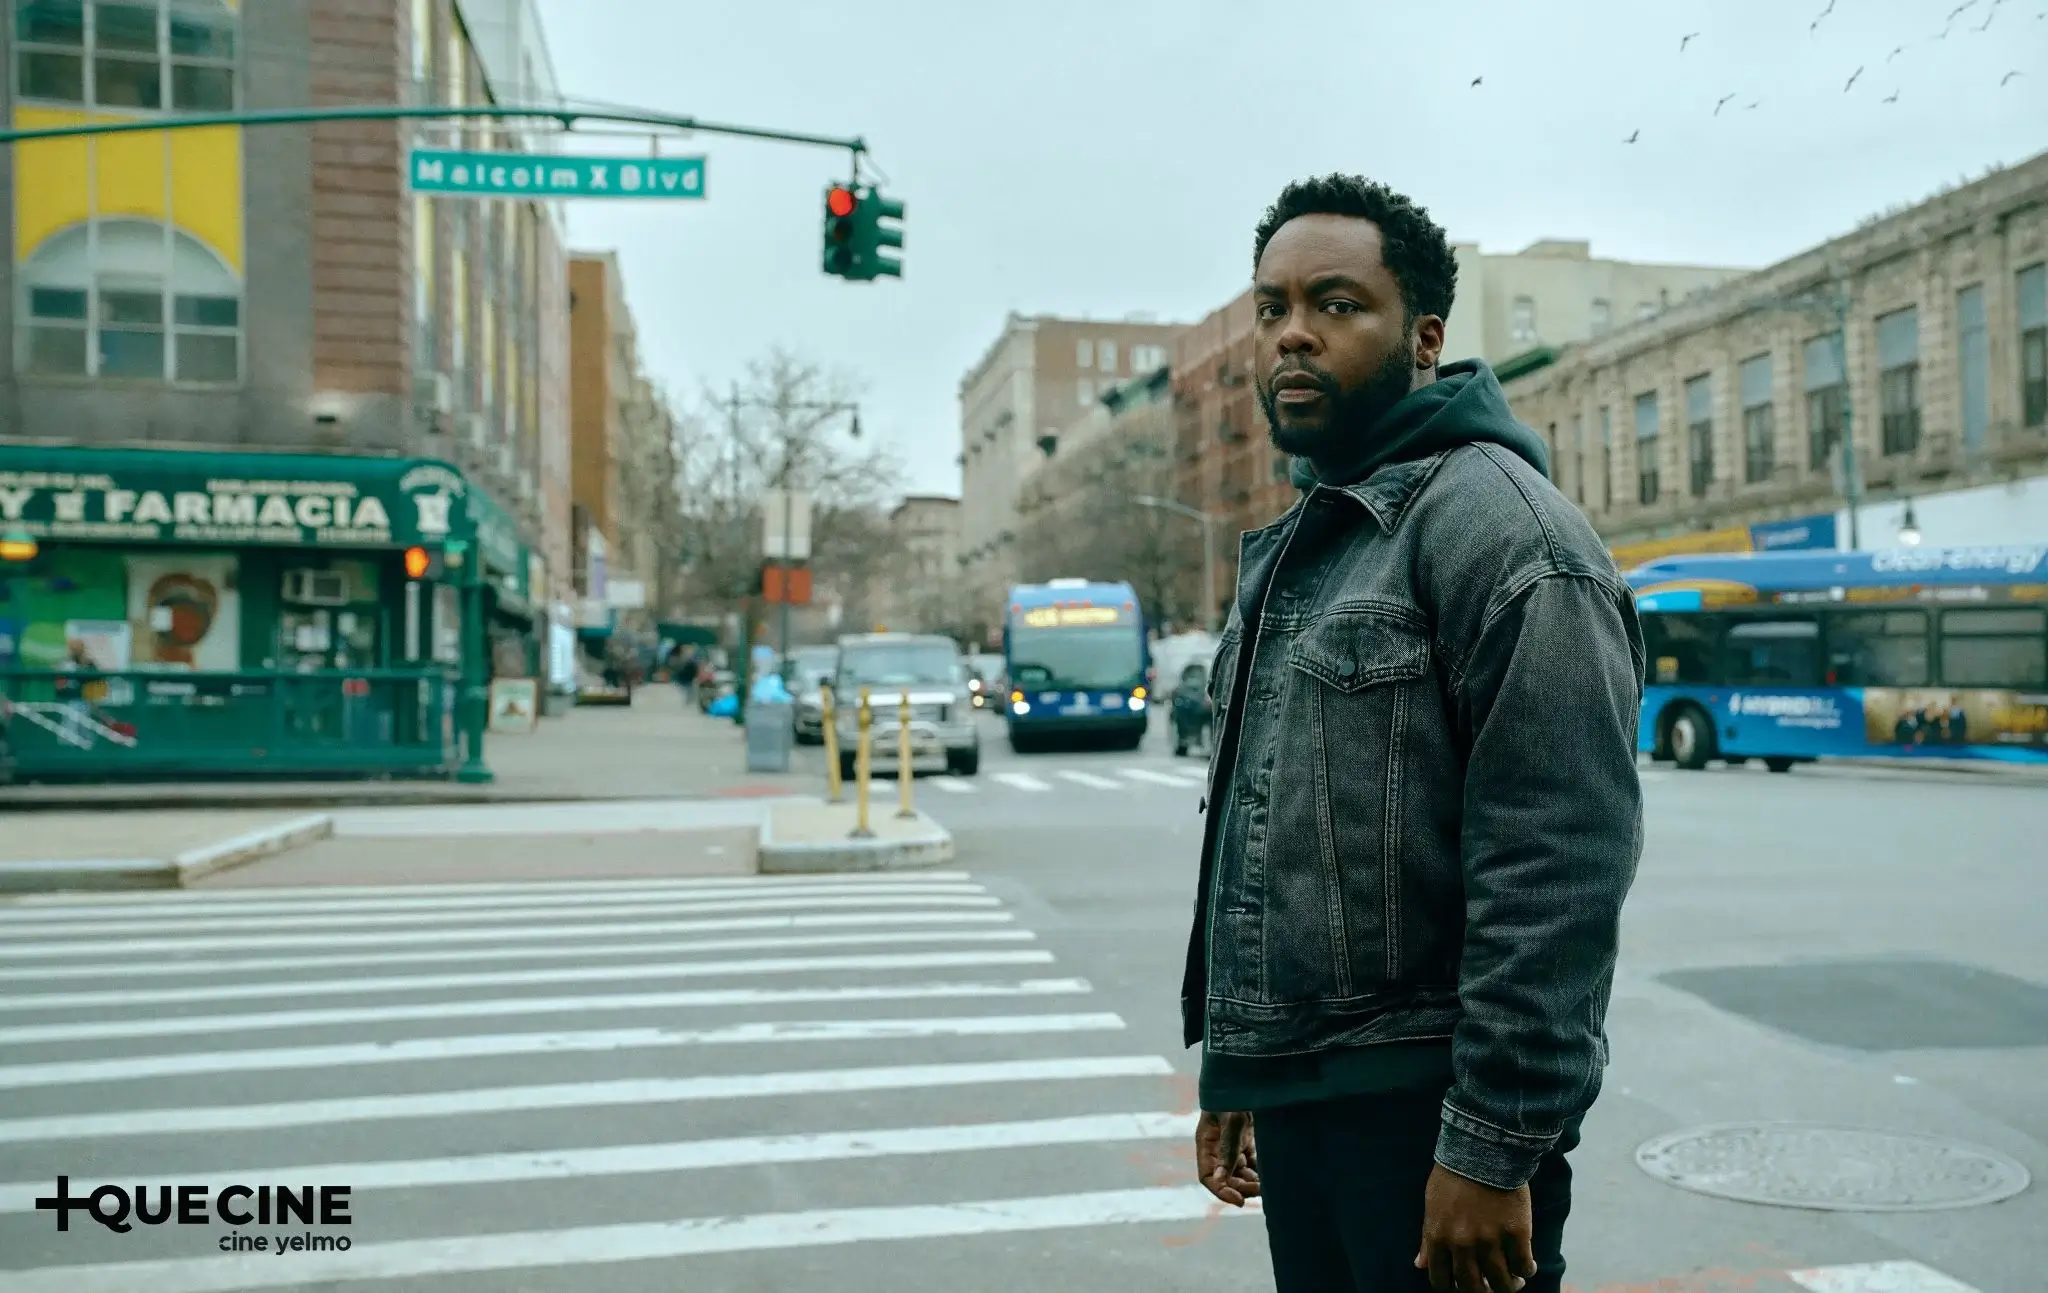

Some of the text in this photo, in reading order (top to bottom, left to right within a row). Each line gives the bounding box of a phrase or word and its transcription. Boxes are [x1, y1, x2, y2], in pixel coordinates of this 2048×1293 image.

[417, 158, 699, 191] Malcolm X Blvd
